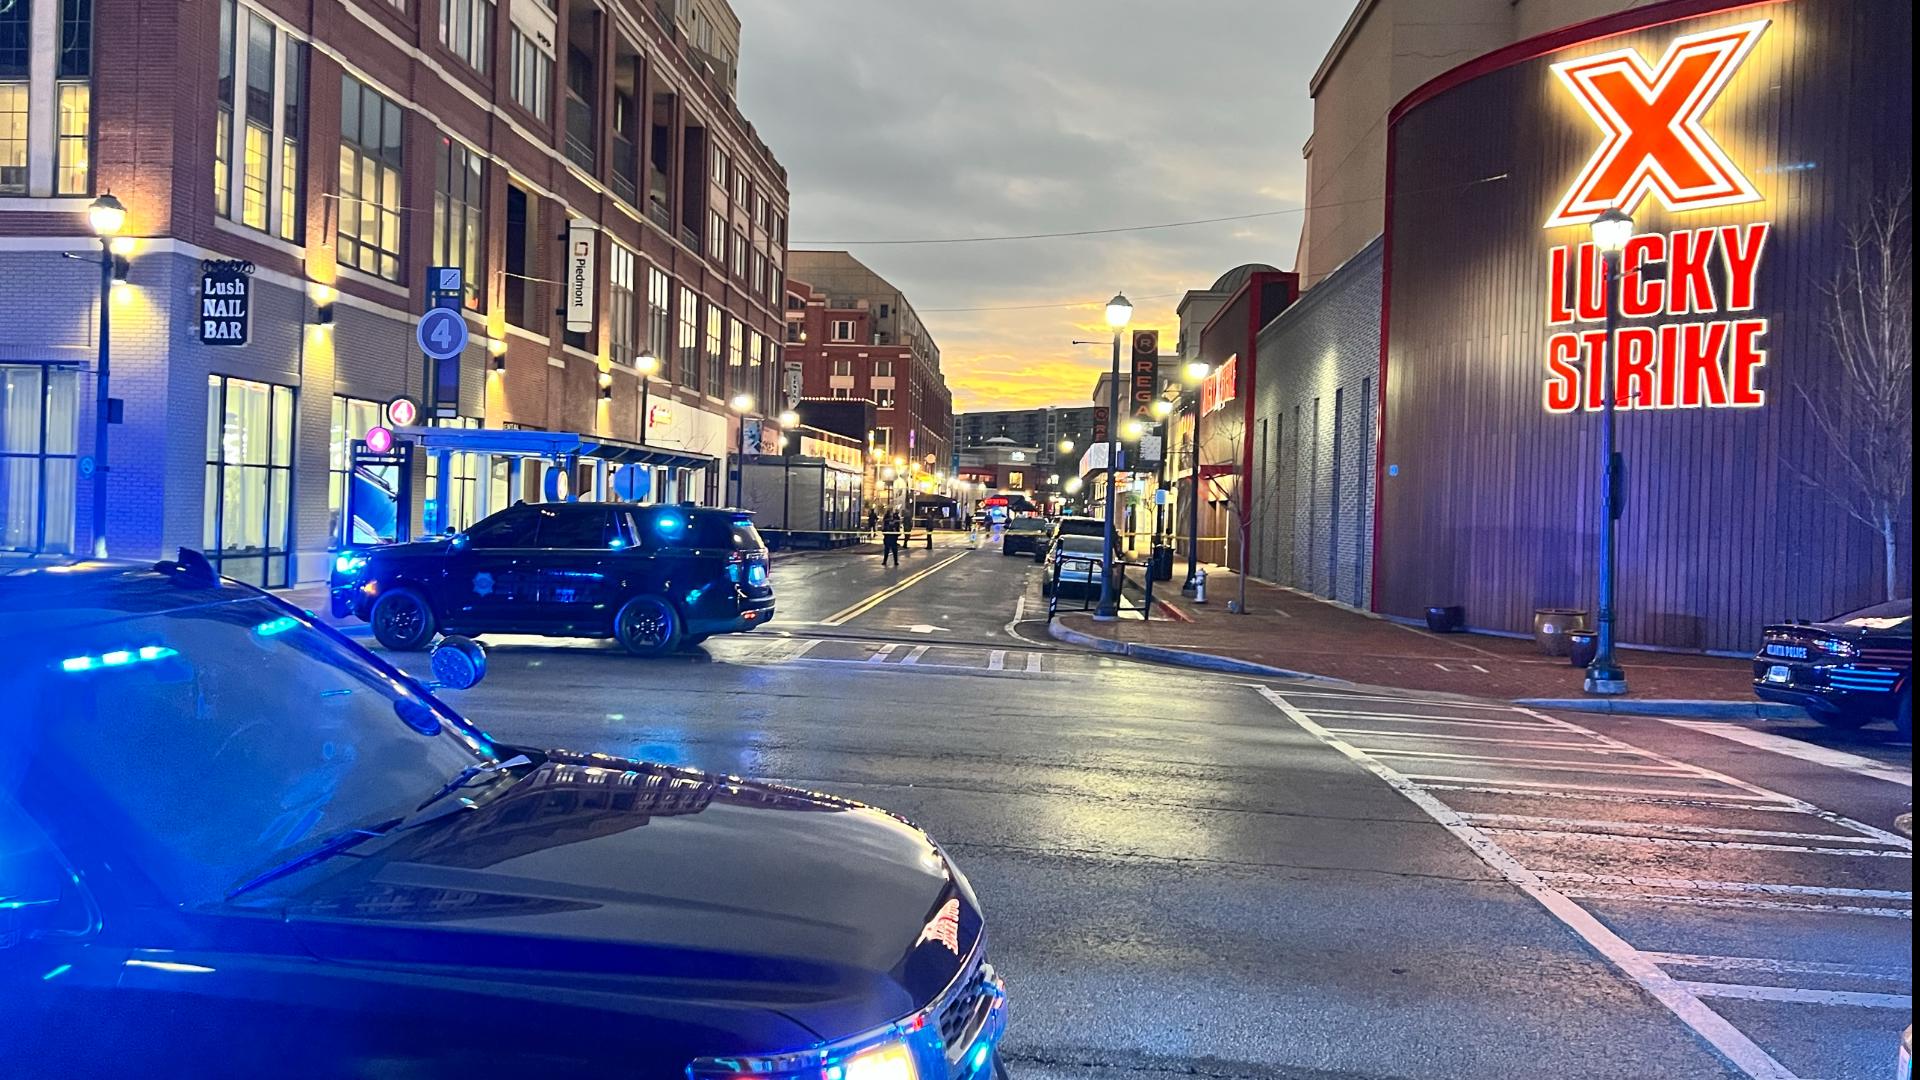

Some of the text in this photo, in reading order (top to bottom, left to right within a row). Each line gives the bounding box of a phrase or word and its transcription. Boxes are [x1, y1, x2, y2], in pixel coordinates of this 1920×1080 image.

[1543, 19, 1773, 228] X
[204, 278, 245, 295] Lush
[575, 258, 586, 307] Piedmont
[1547, 222, 1770, 327] LUCKY
[202, 299, 245, 317] NAIL
[203, 320, 242, 339] BAR
[430, 318, 452, 349] 4
[1545, 317, 1769, 414] STRIKE
[393, 402, 409, 424] 4
[370, 431, 386, 448] 4
